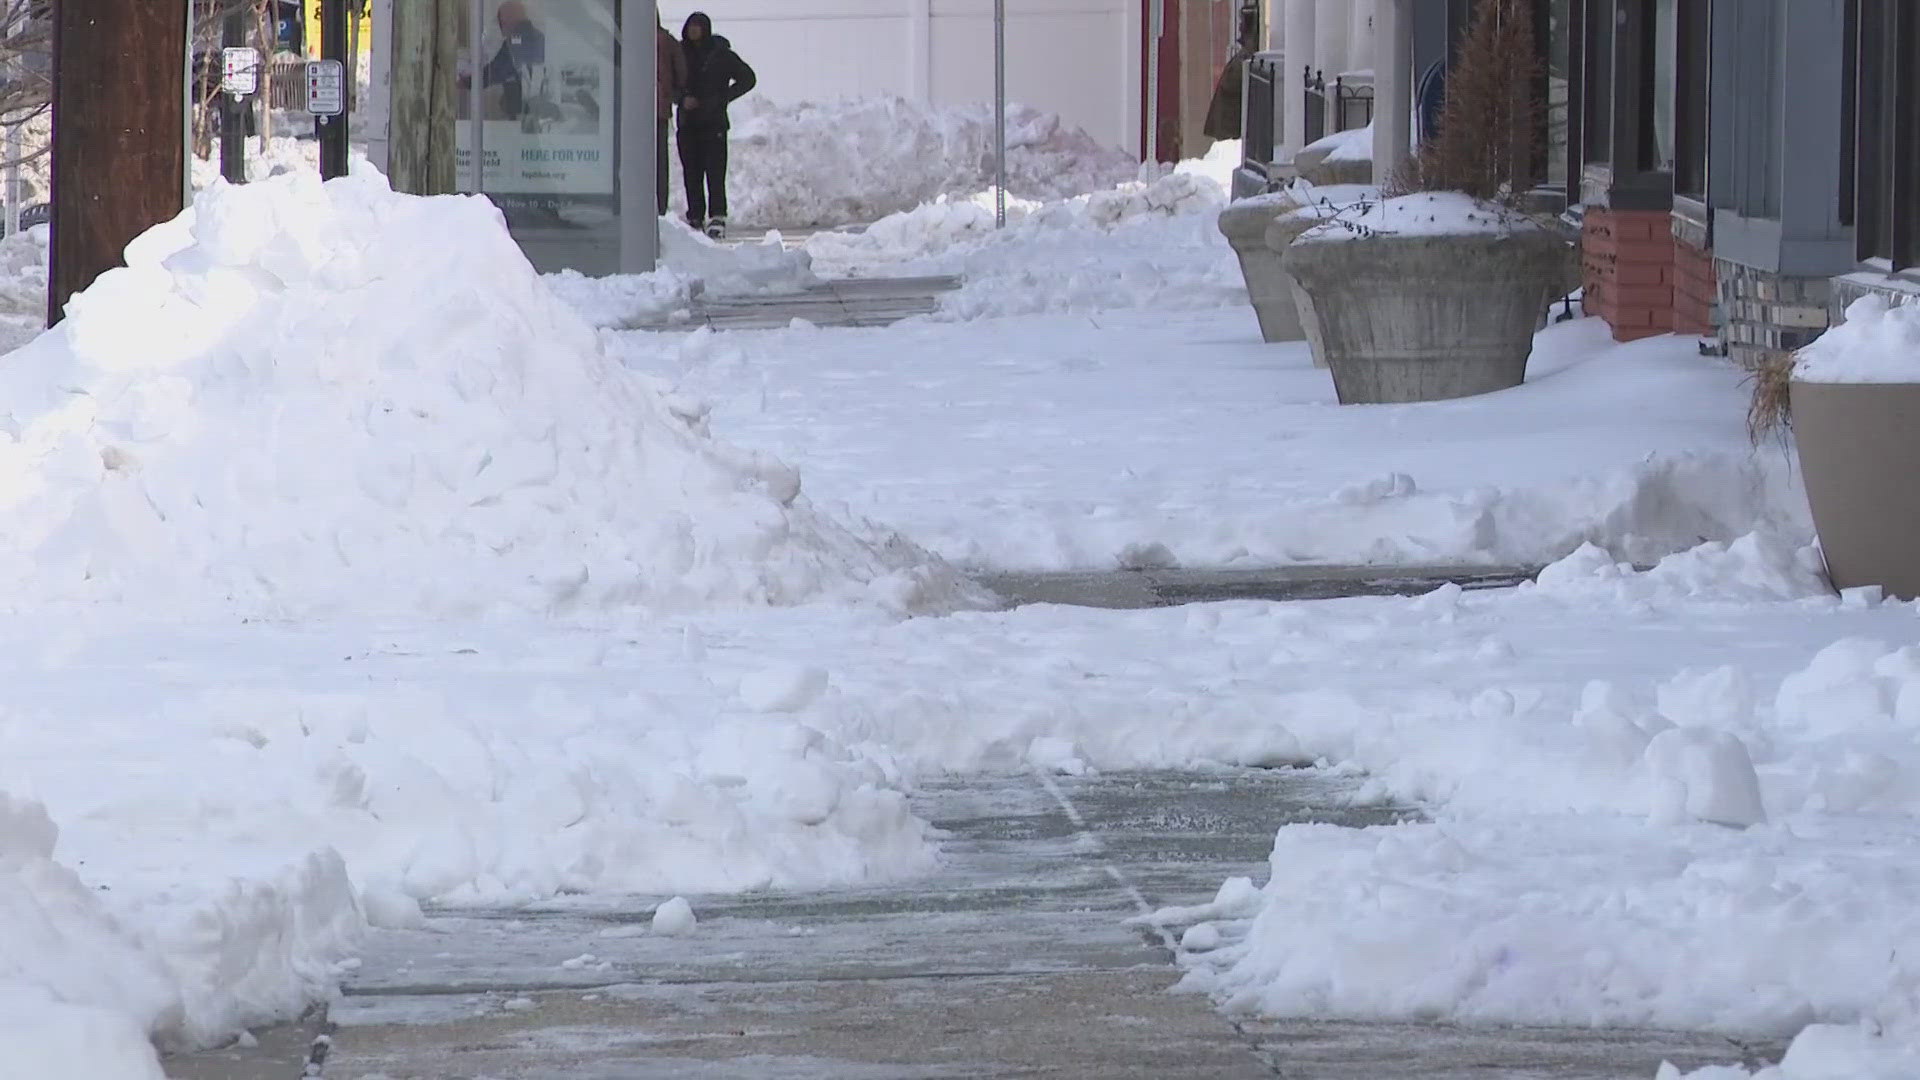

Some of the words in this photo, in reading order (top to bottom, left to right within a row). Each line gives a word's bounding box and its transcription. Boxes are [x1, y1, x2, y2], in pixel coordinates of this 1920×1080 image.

[521, 149, 548, 161] HERE
[552, 150, 574, 161] FOR
[576, 150, 600, 162] YOU
[529, 200, 539, 208] 10
